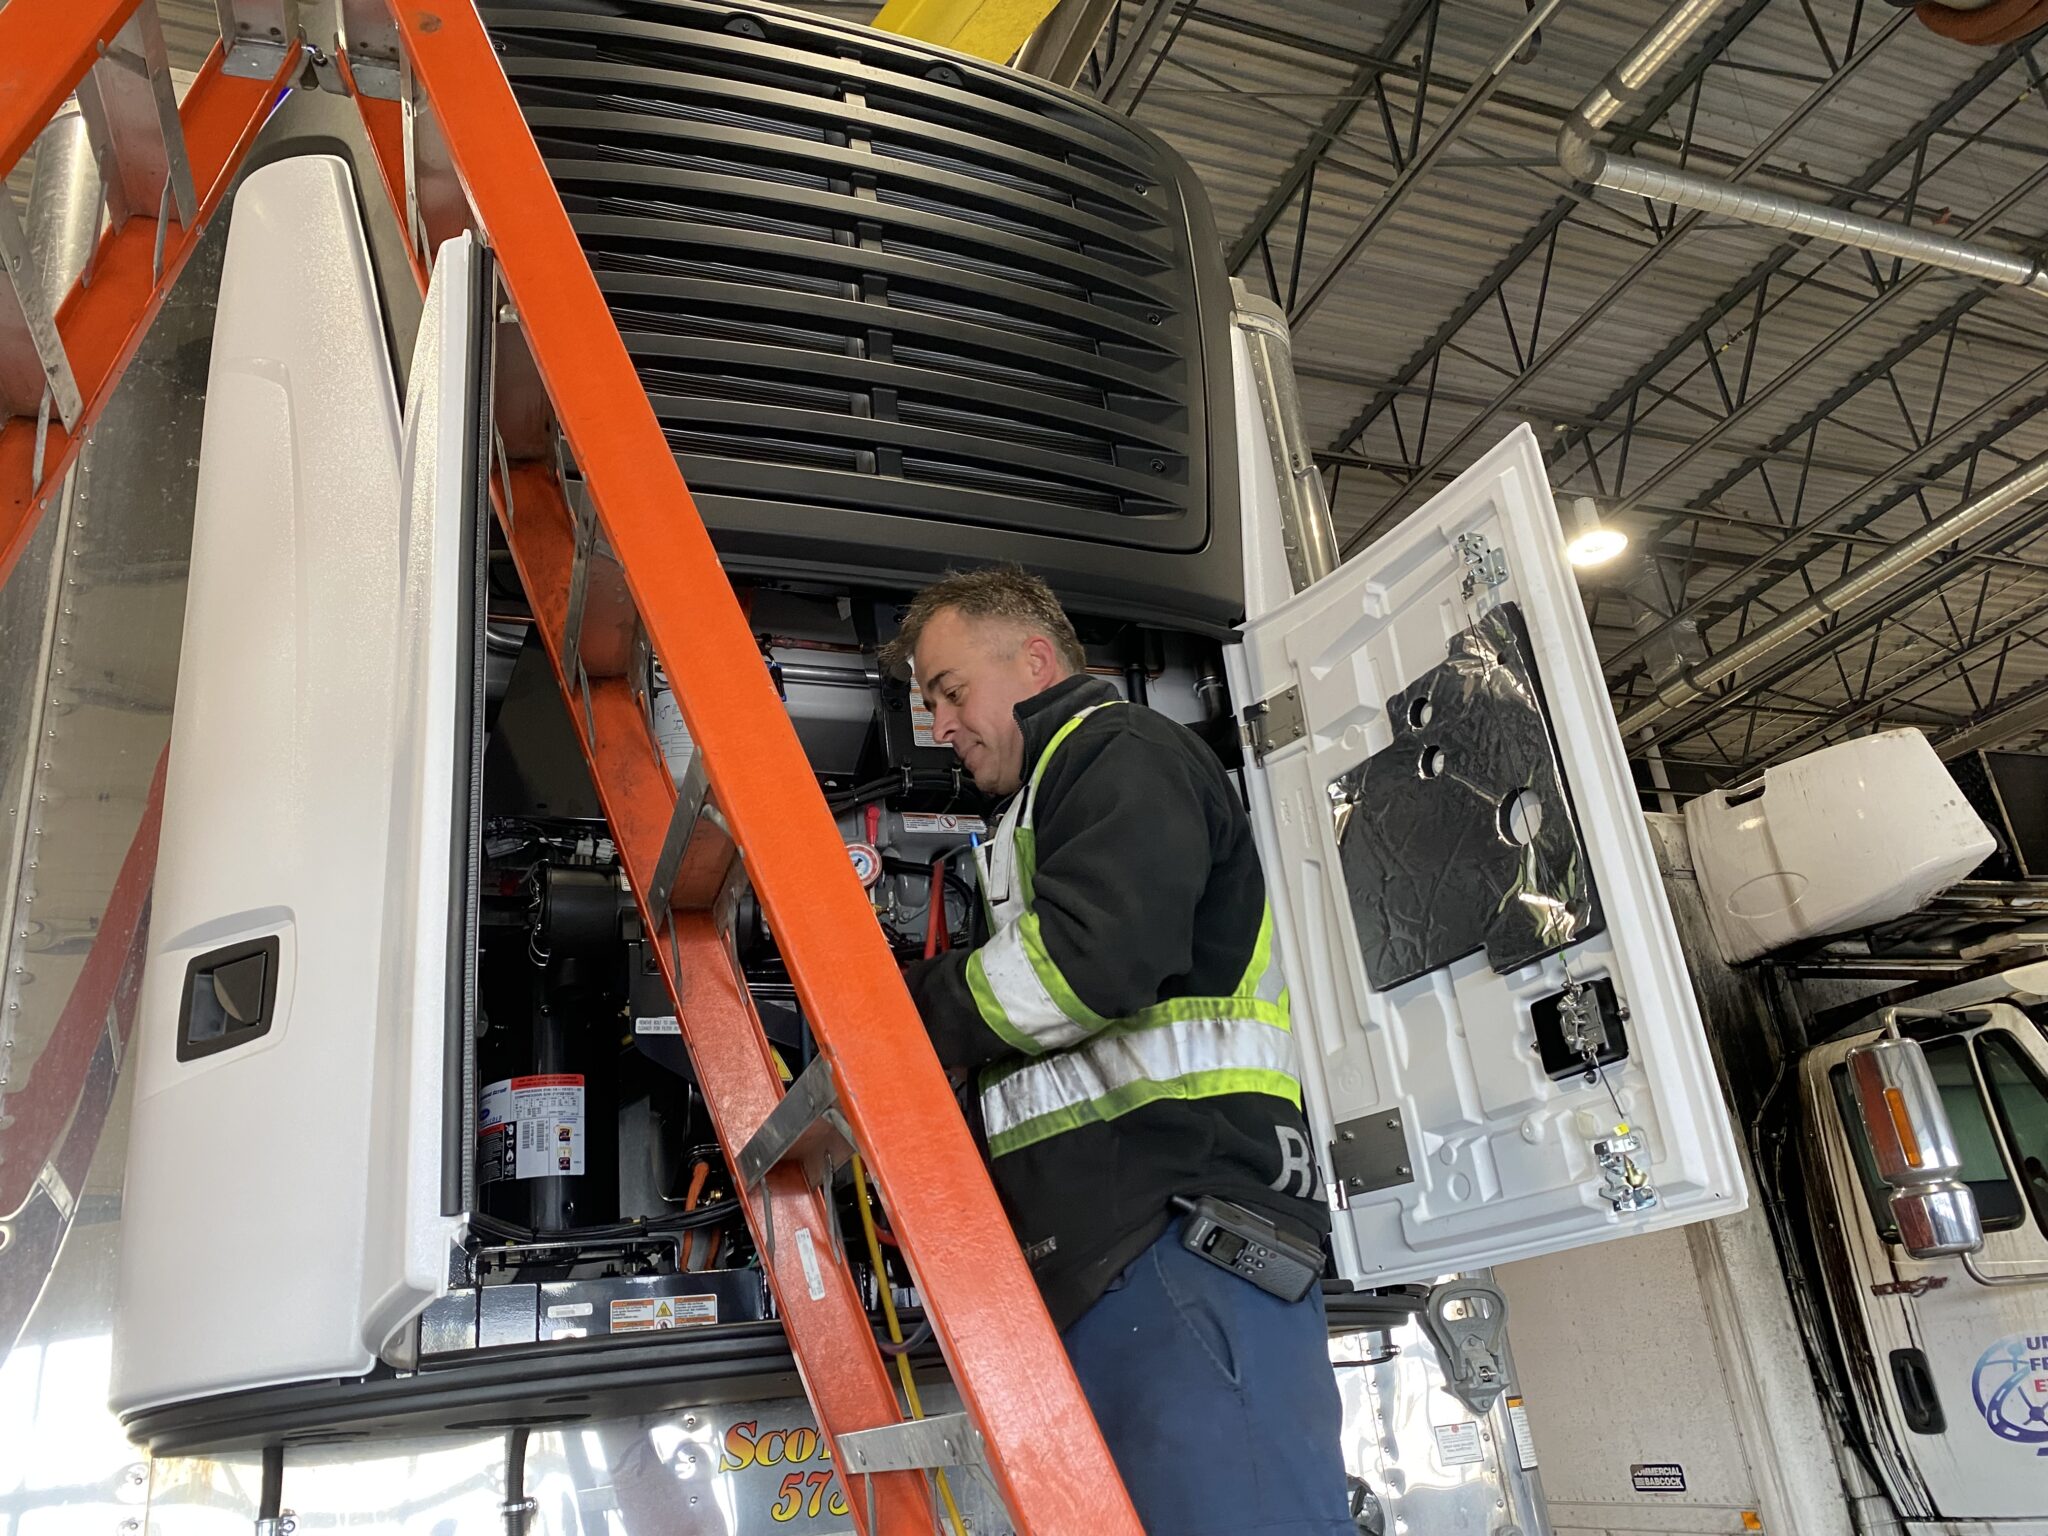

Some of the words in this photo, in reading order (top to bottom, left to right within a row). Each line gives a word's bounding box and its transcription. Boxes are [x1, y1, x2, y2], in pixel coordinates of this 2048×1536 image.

[2034, 1378, 2048, 1393] E
[1634, 1467, 1682, 1476] OMMERCIAL
[1644, 1477, 1681, 1486] BABCOCK
